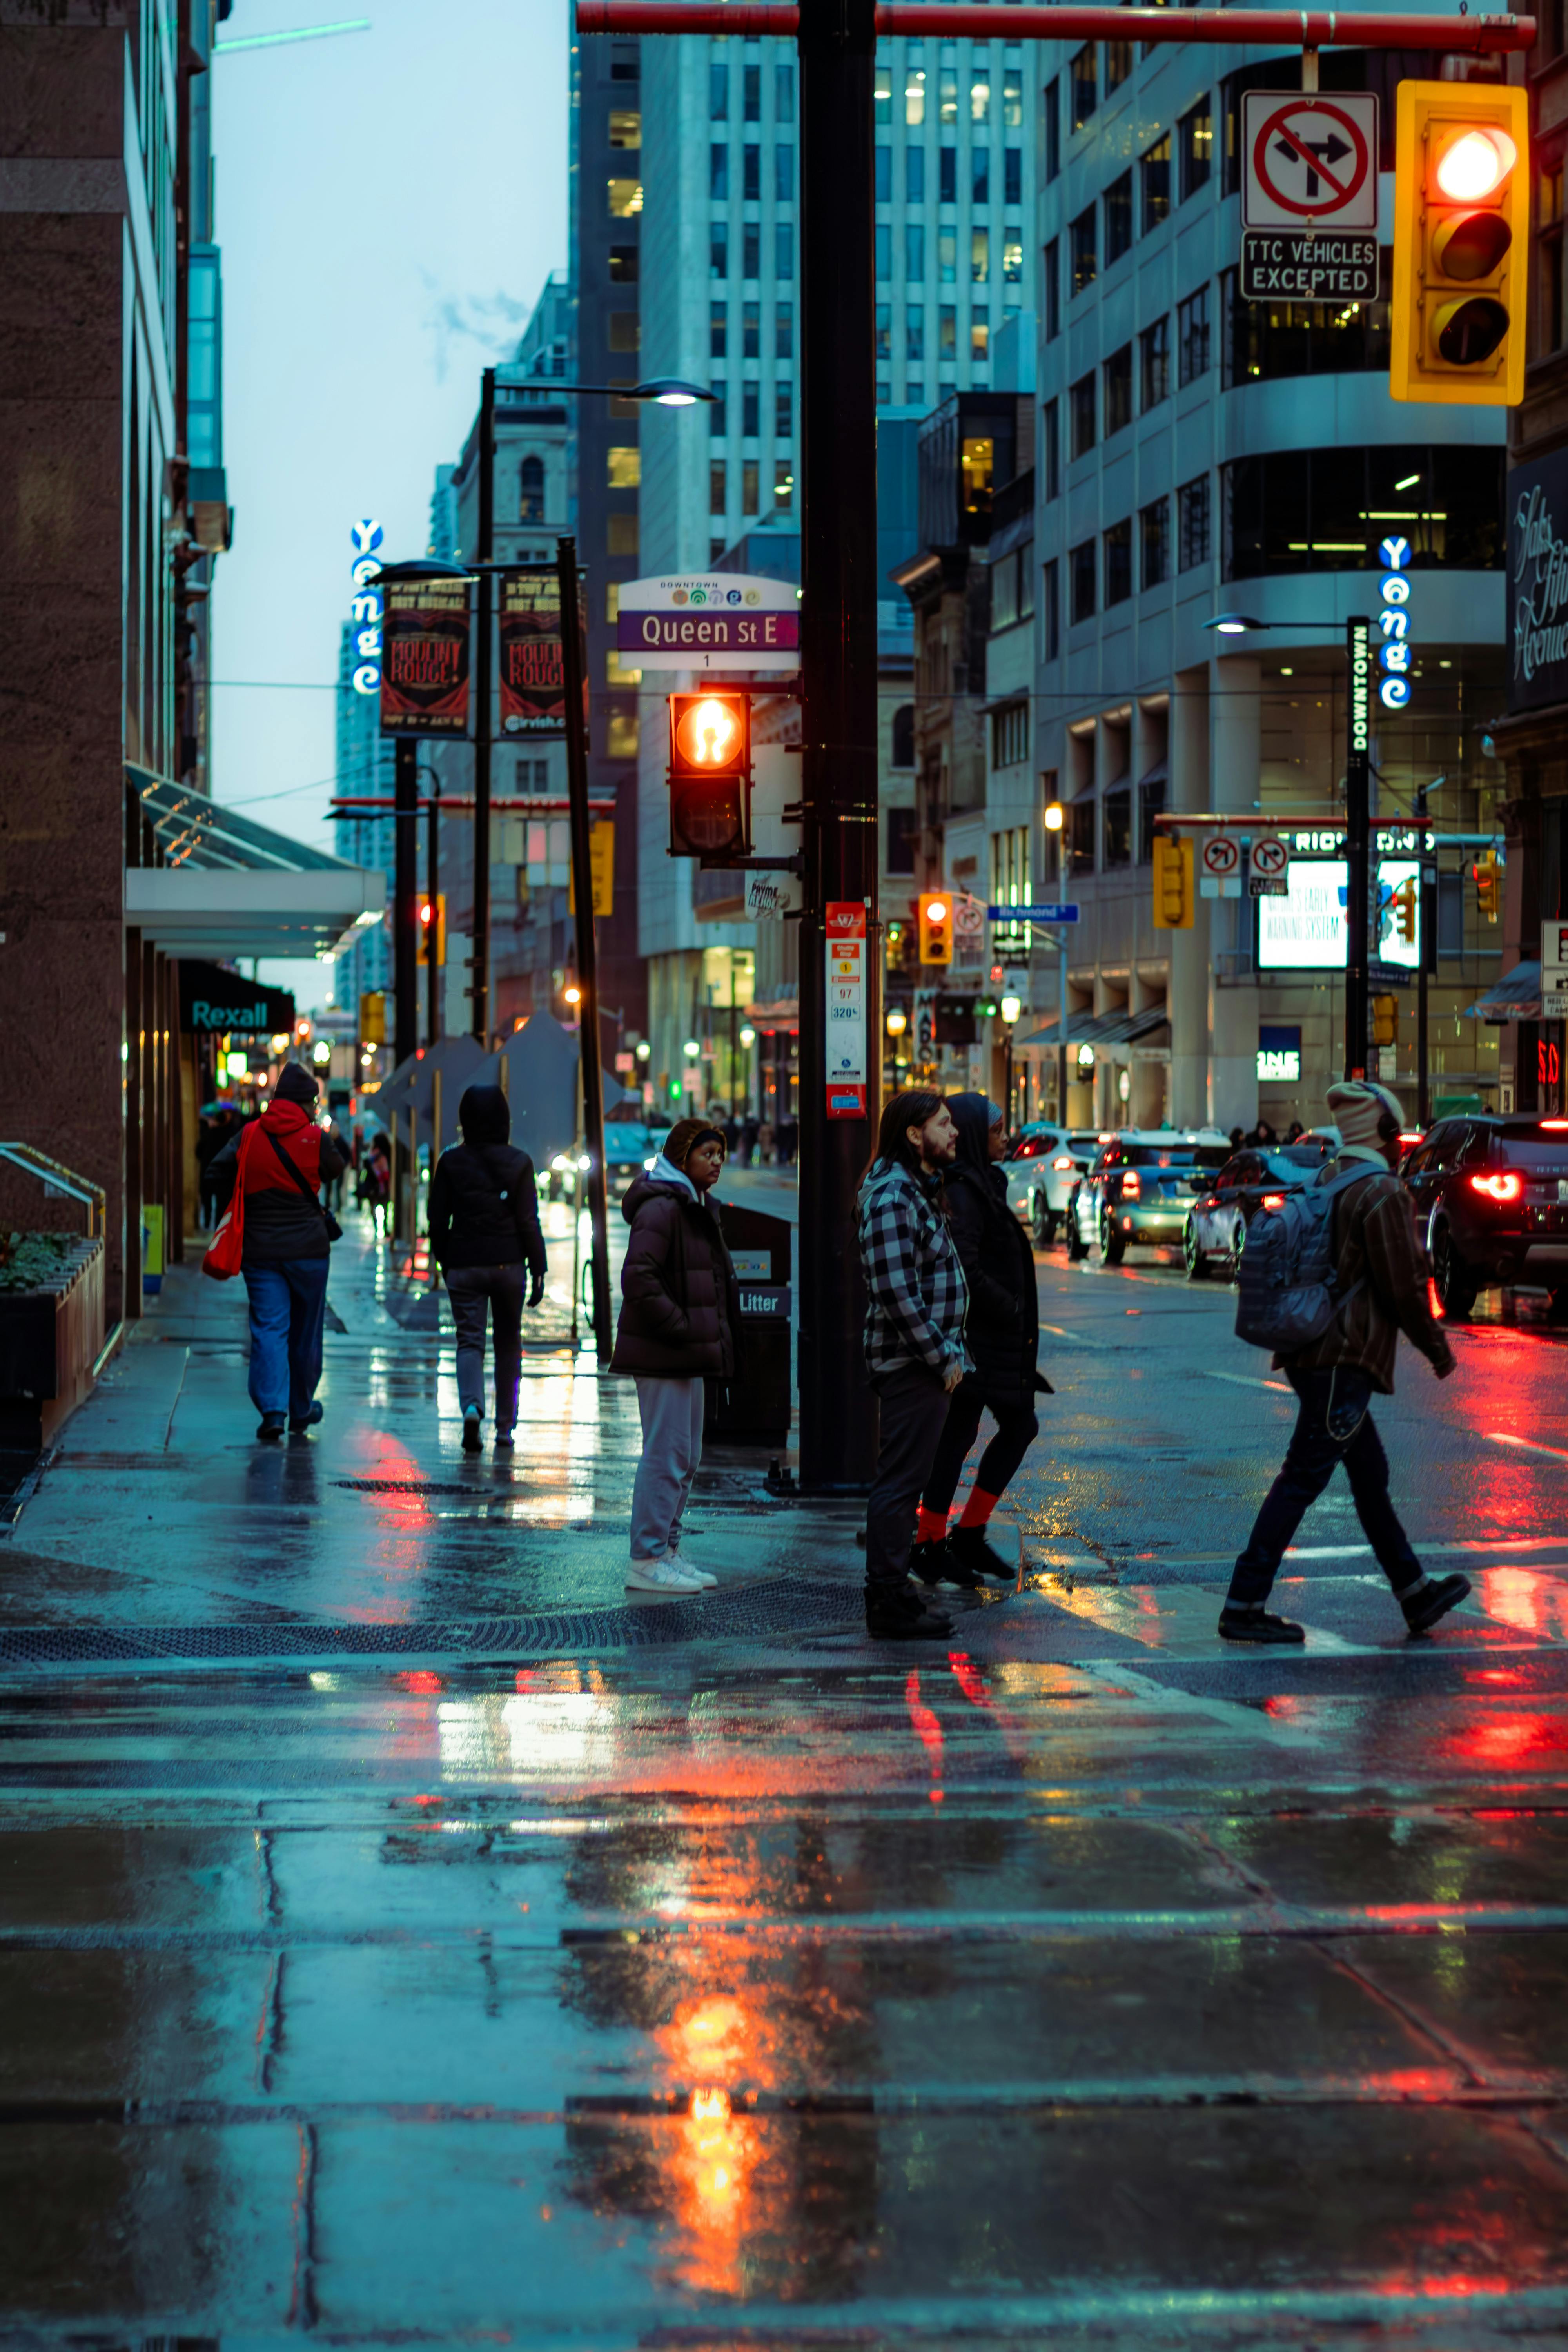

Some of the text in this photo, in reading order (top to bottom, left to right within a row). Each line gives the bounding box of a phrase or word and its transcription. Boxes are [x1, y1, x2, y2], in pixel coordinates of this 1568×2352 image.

[1248, 240, 1374, 264] TTC VEHICLES
[1253, 267, 1368, 291] EXCEPTED
[351, 519, 384, 695] Yonge
[643, 616, 777, 645] Queen St E
[1378, 537, 1410, 709] Yonge
[704, 655, 709, 666] 1
[1353, 626, 1367, 751] DOWNTOWN
[1305, 887, 1329, 912] EARLY
[1305, 916, 1339, 940] SYSTEM
[840, 988, 851, 999] 97
[192, 1000, 268, 1030] Rexall
[833, 1007, 852, 1018] 320
[740, 1293, 778, 1311] Litter
